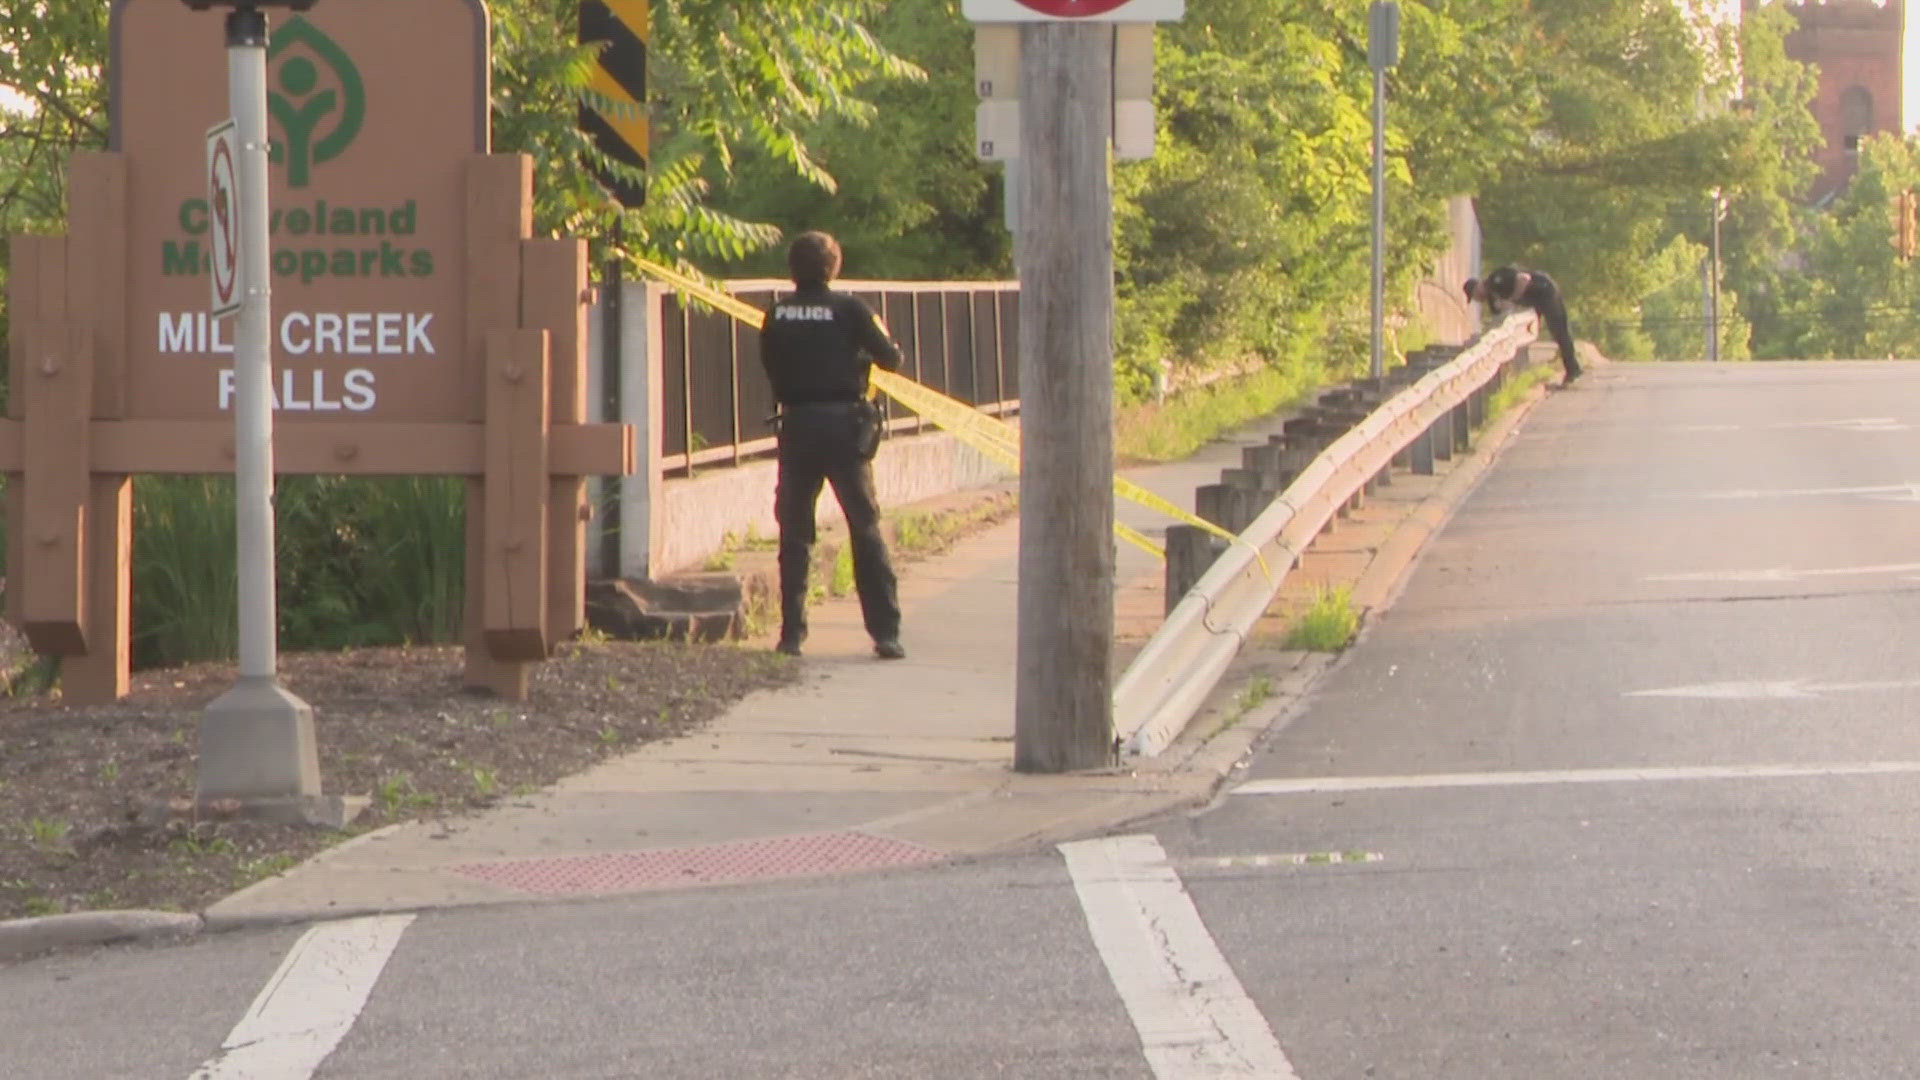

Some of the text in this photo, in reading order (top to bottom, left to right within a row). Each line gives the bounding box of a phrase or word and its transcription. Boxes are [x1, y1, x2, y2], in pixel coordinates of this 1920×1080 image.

[178, 199, 416, 235] Celand
[162, 240, 434, 283] Moparks
[158, 311, 435, 354] MIL CREEK
[774, 305, 834, 321] POLICE
[218, 368, 376, 410] FLLS
